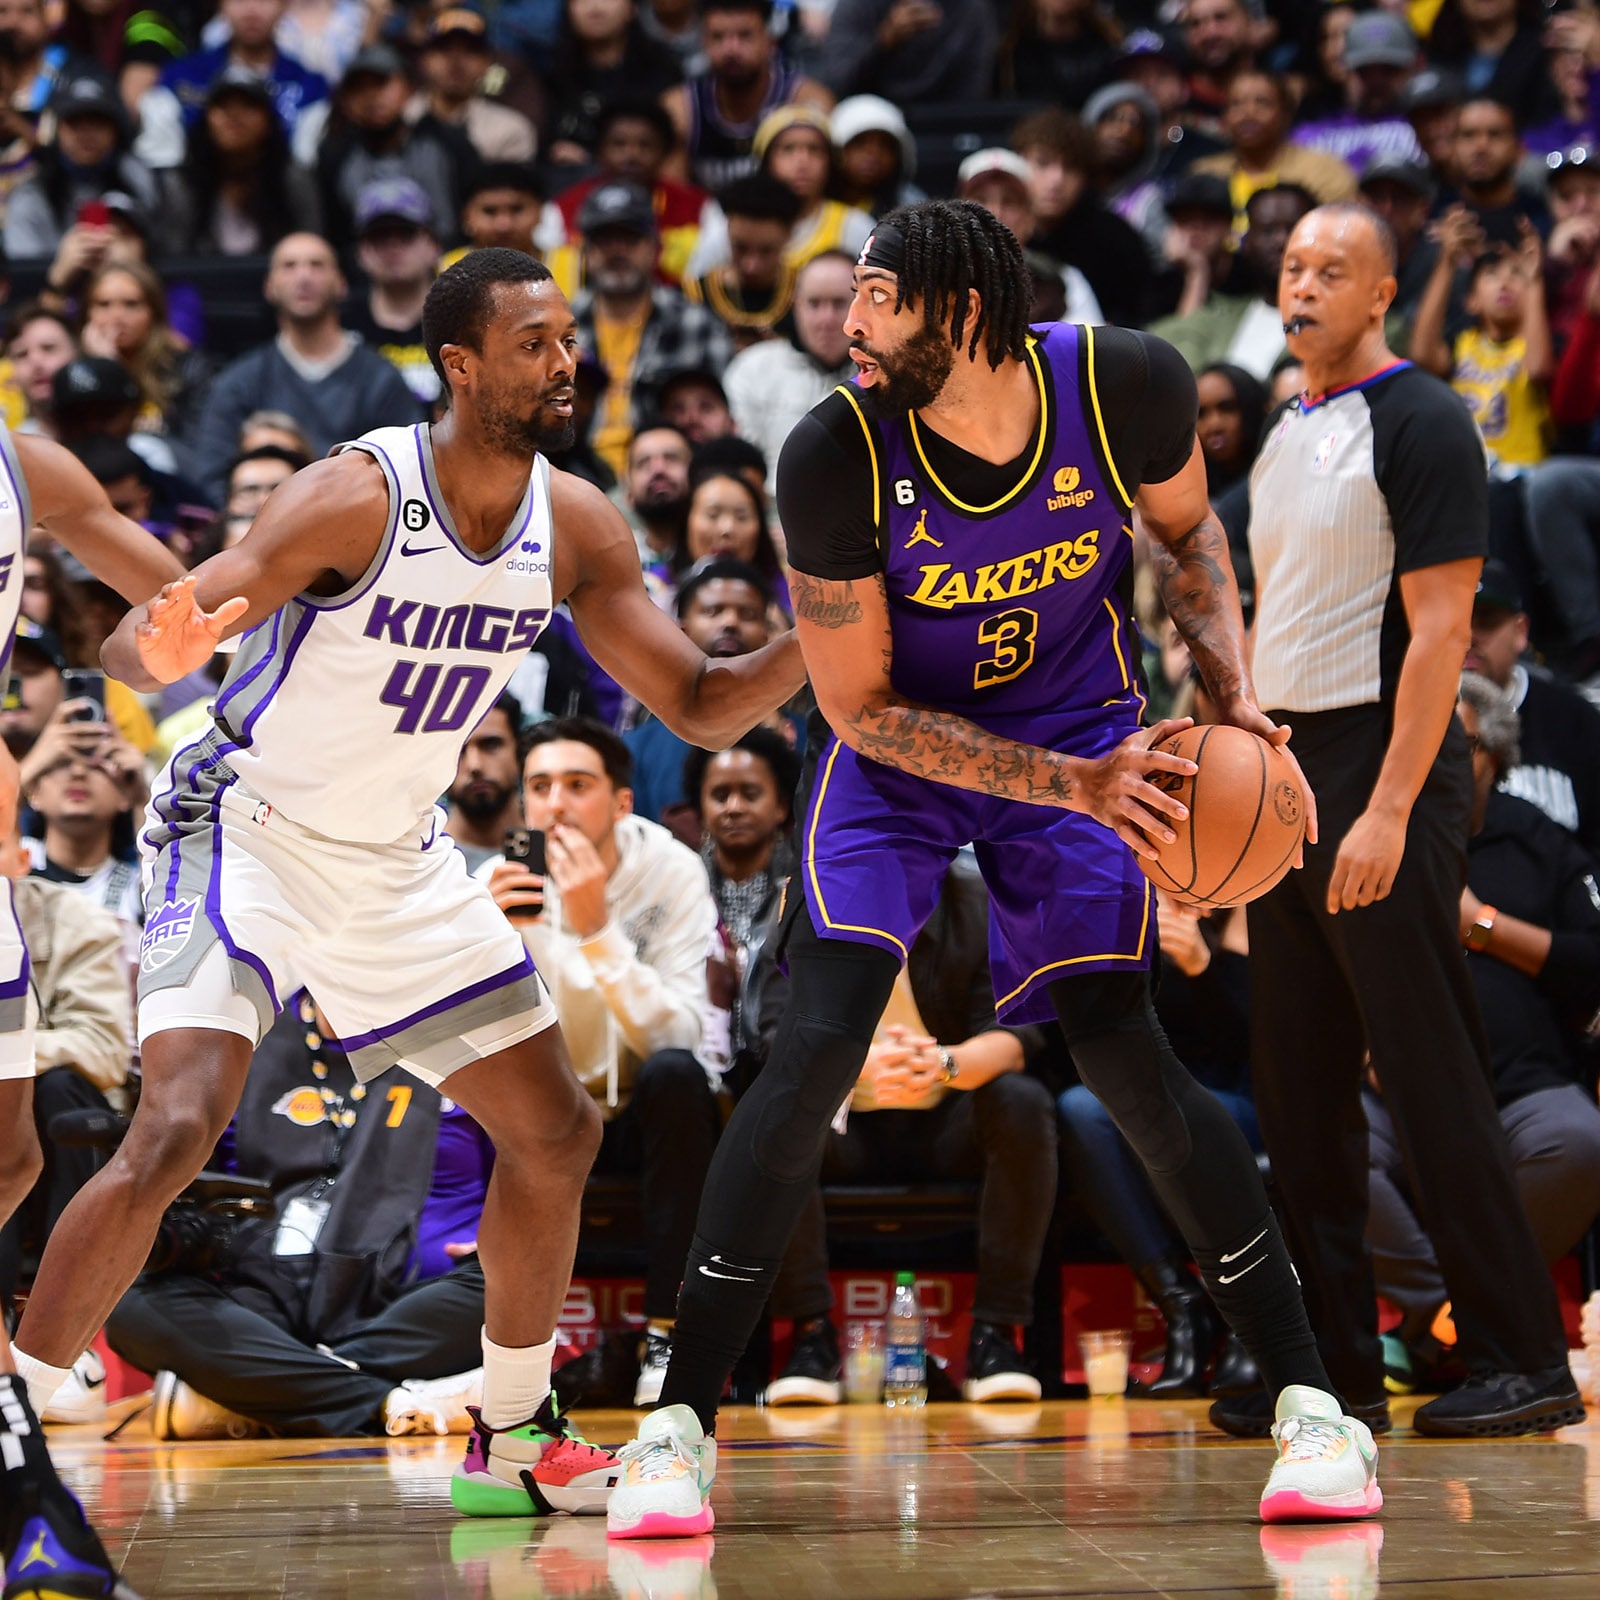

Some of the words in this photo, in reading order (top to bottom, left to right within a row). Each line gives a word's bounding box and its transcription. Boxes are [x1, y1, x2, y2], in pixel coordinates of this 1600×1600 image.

[895, 479, 915, 505] 6
[1047, 489, 1094, 511] bibigo
[407, 502, 423, 529] 6
[506, 559, 549, 574] dialpa
[904, 529, 1100, 609] LAKERS
[363, 594, 550, 654] KINGS
[974, 607, 1038, 690] 3
[379, 659, 493, 735] 40
[143, 920, 191, 953] SAC
[846, 1280, 953, 1316] BO
